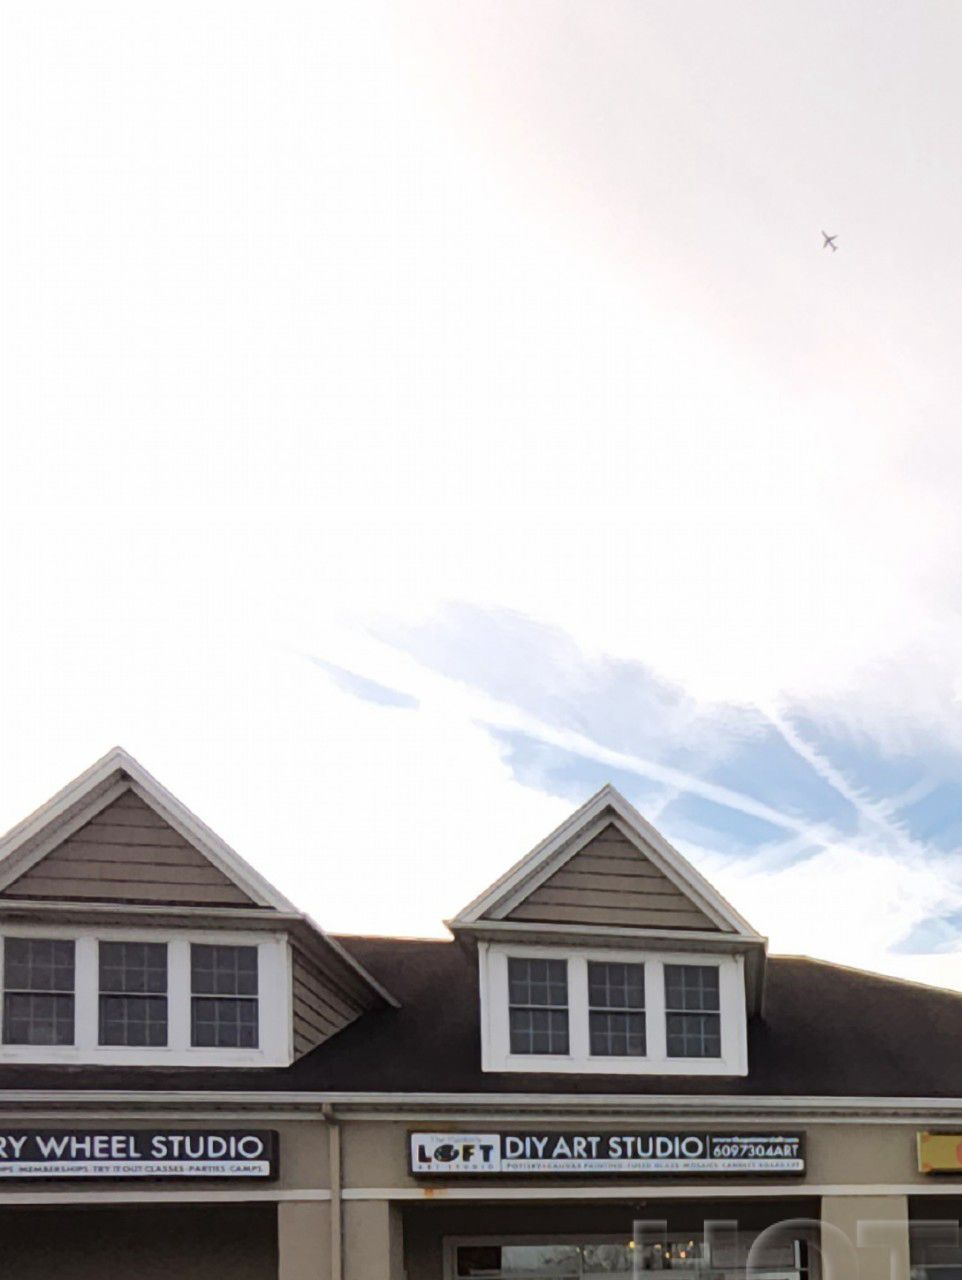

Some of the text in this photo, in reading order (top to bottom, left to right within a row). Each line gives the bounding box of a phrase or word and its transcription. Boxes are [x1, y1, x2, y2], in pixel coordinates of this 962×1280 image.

[36, 1136, 142, 1158] WHEEL
[151, 1135, 264, 1159] STUDIO
[417, 1144, 494, 1163] LOFT
[506, 1136, 704, 1158] DIY ART STUDIO
[713, 1144, 799, 1157] 6097304ART
